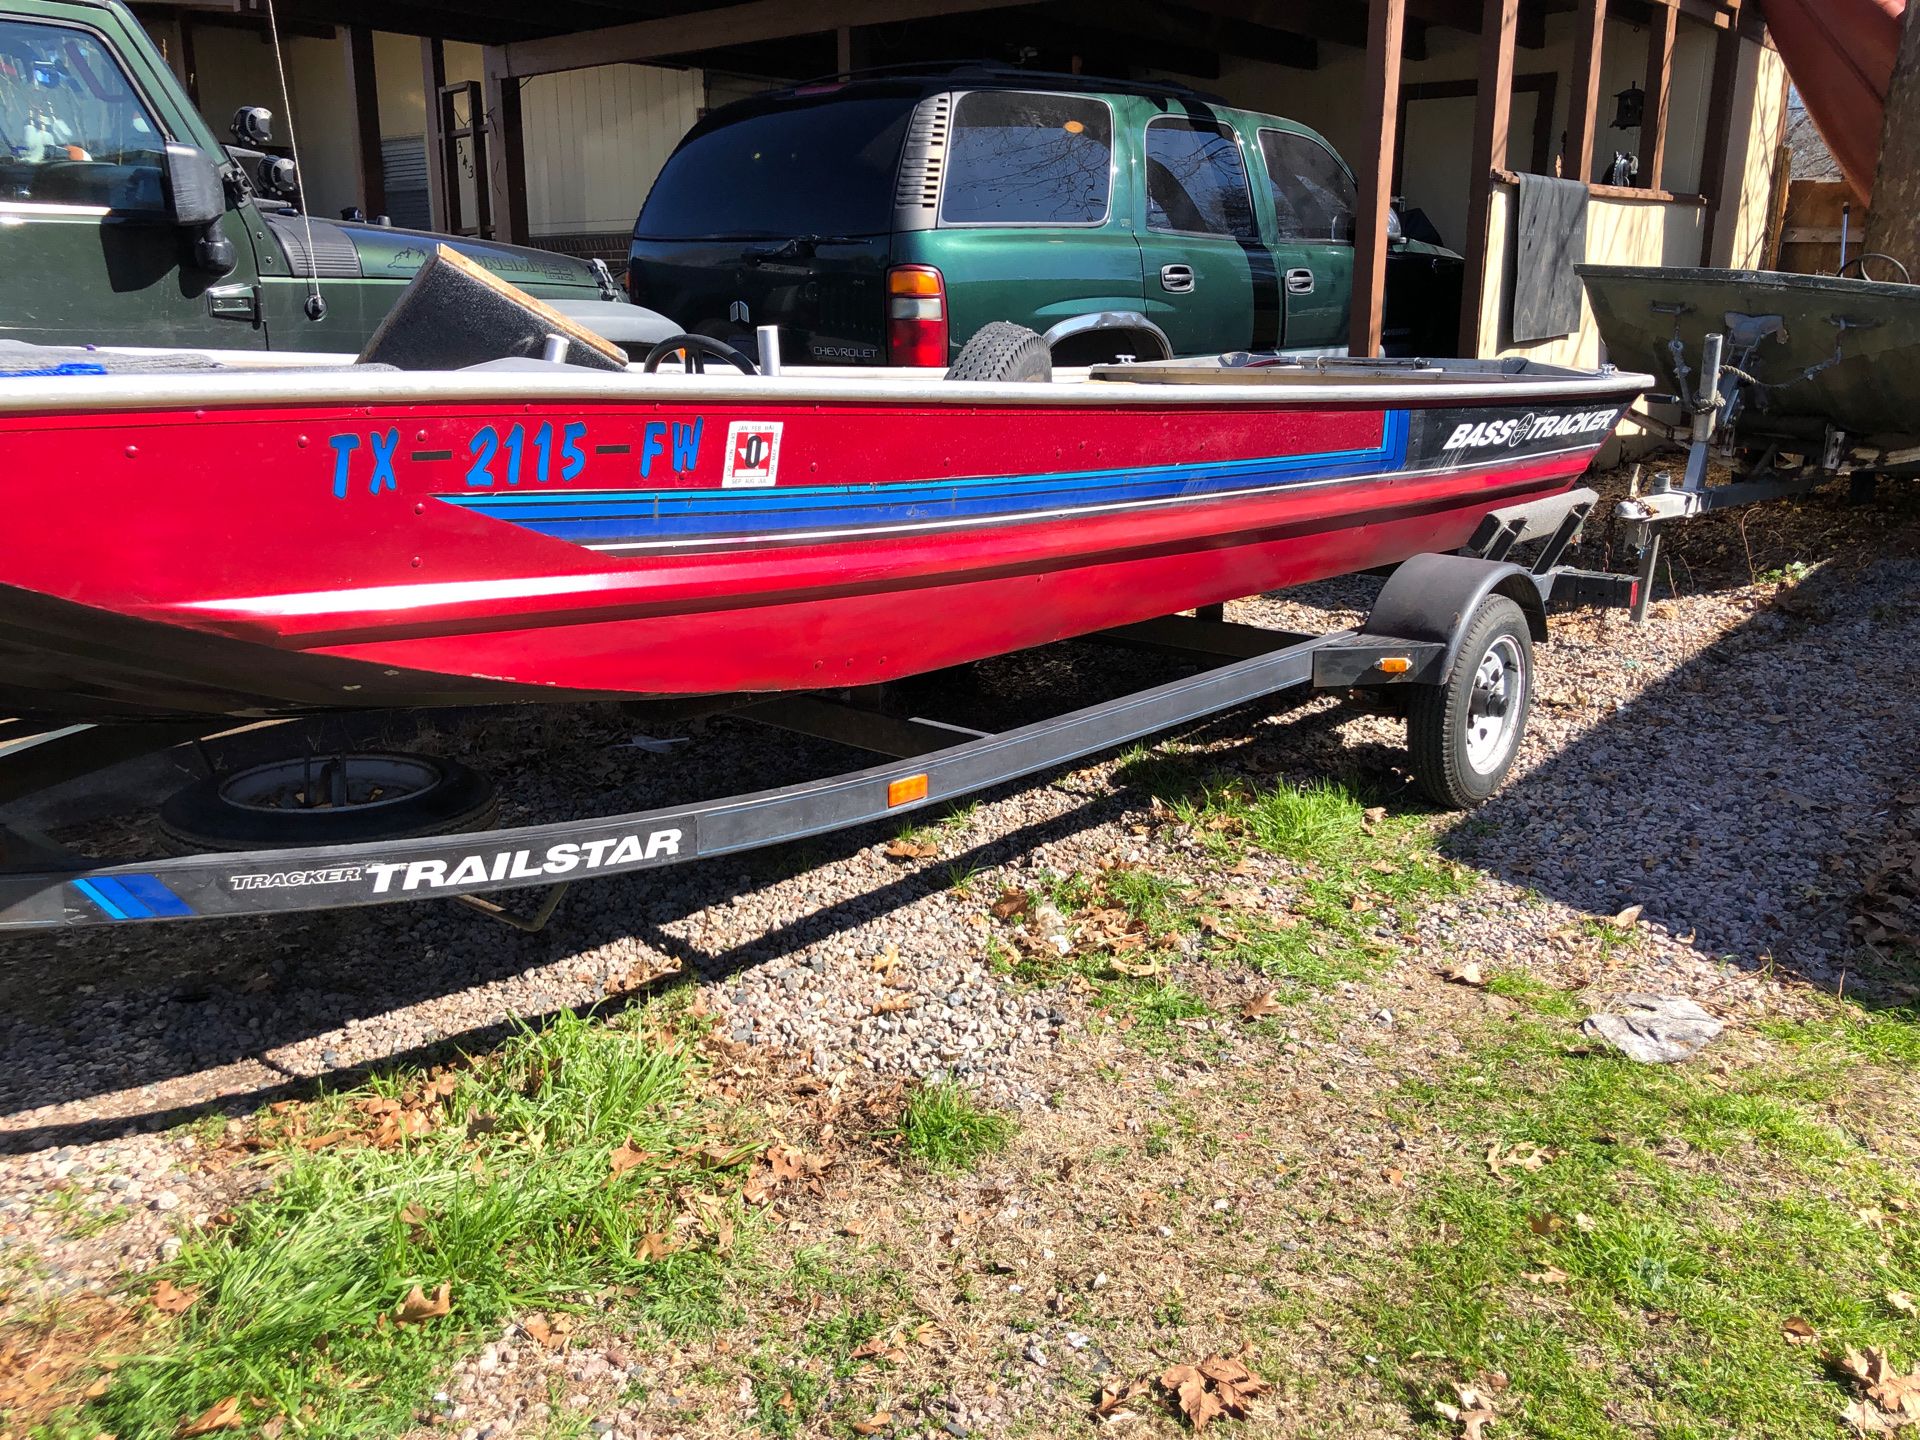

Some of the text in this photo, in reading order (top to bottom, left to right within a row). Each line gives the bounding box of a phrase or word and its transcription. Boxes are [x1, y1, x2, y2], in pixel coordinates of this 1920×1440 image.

[458, 140, 474, 179] 343
[813, 346, 878, 358] CHEVROLET
[1442, 408, 1618, 450] BASS TRACKER
[329, 427, 399, 499] TX
[466, 420, 587, 487] 2115
[640, 415, 704, 479] FW
[231, 828, 683, 894] TRACKER TRAILSTAR
